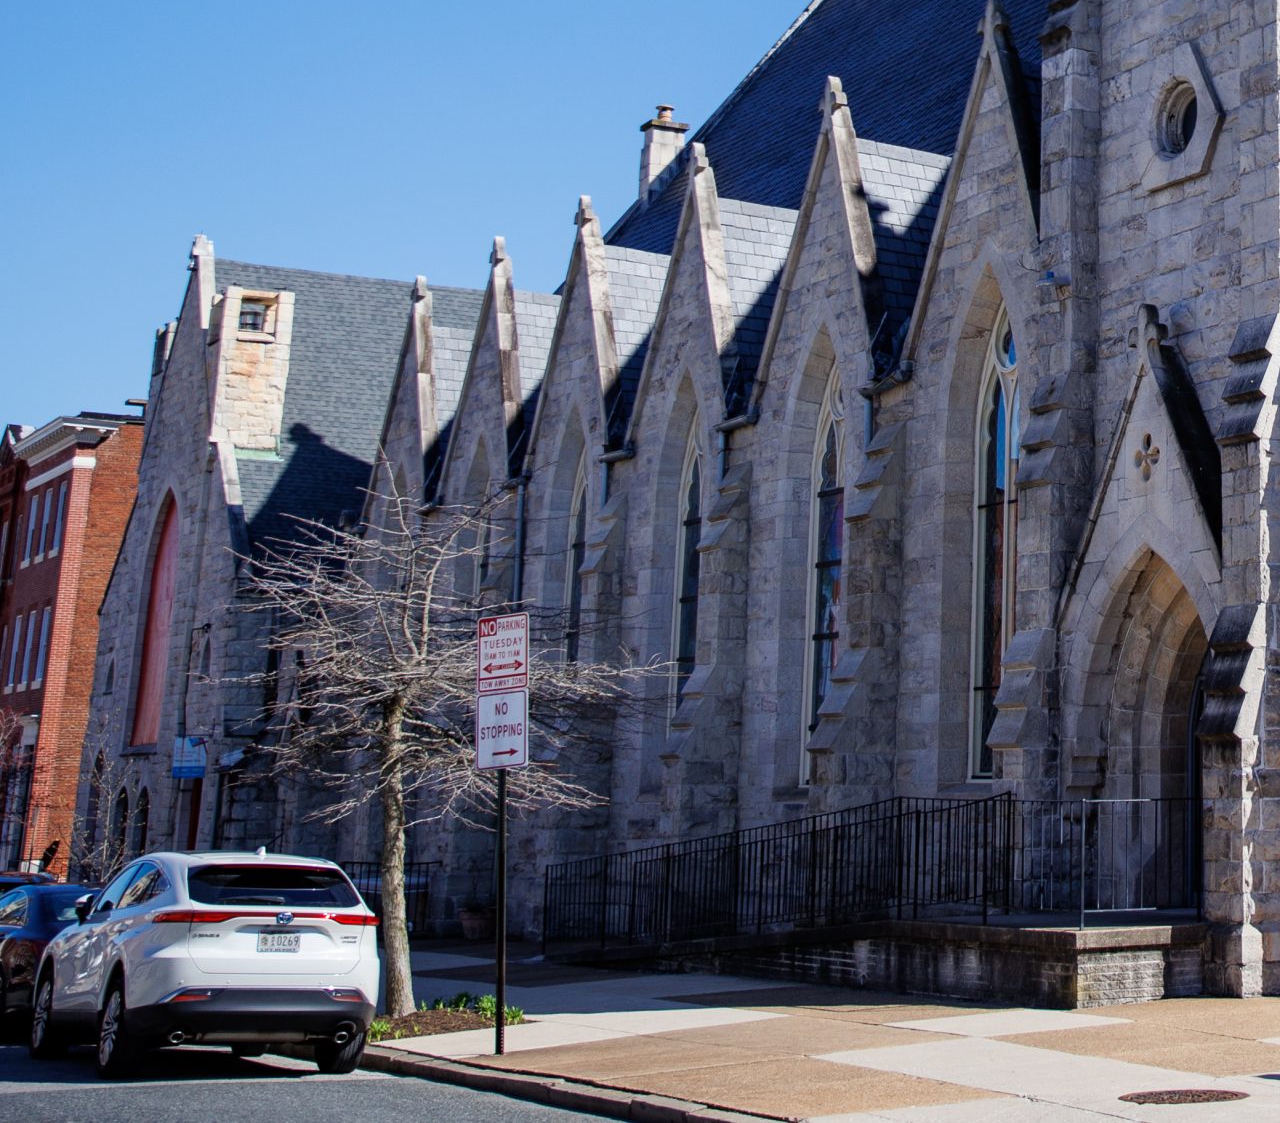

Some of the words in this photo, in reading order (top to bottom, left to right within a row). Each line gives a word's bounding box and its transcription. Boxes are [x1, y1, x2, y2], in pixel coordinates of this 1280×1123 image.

[480, 621, 497, 636] NO
[498, 619, 525, 632] PARKING
[483, 637, 523, 650] TUESDAY
[499, 651, 505, 659] TO
[481, 681, 493, 689] TOW
[494, 679, 510, 687] AWAY
[511, 677, 525, 686] ZONE
[495, 701, 509, 716] NO
[480, 723, 523, 740] STOPPING
[277, 935, 299, 947] 0269
